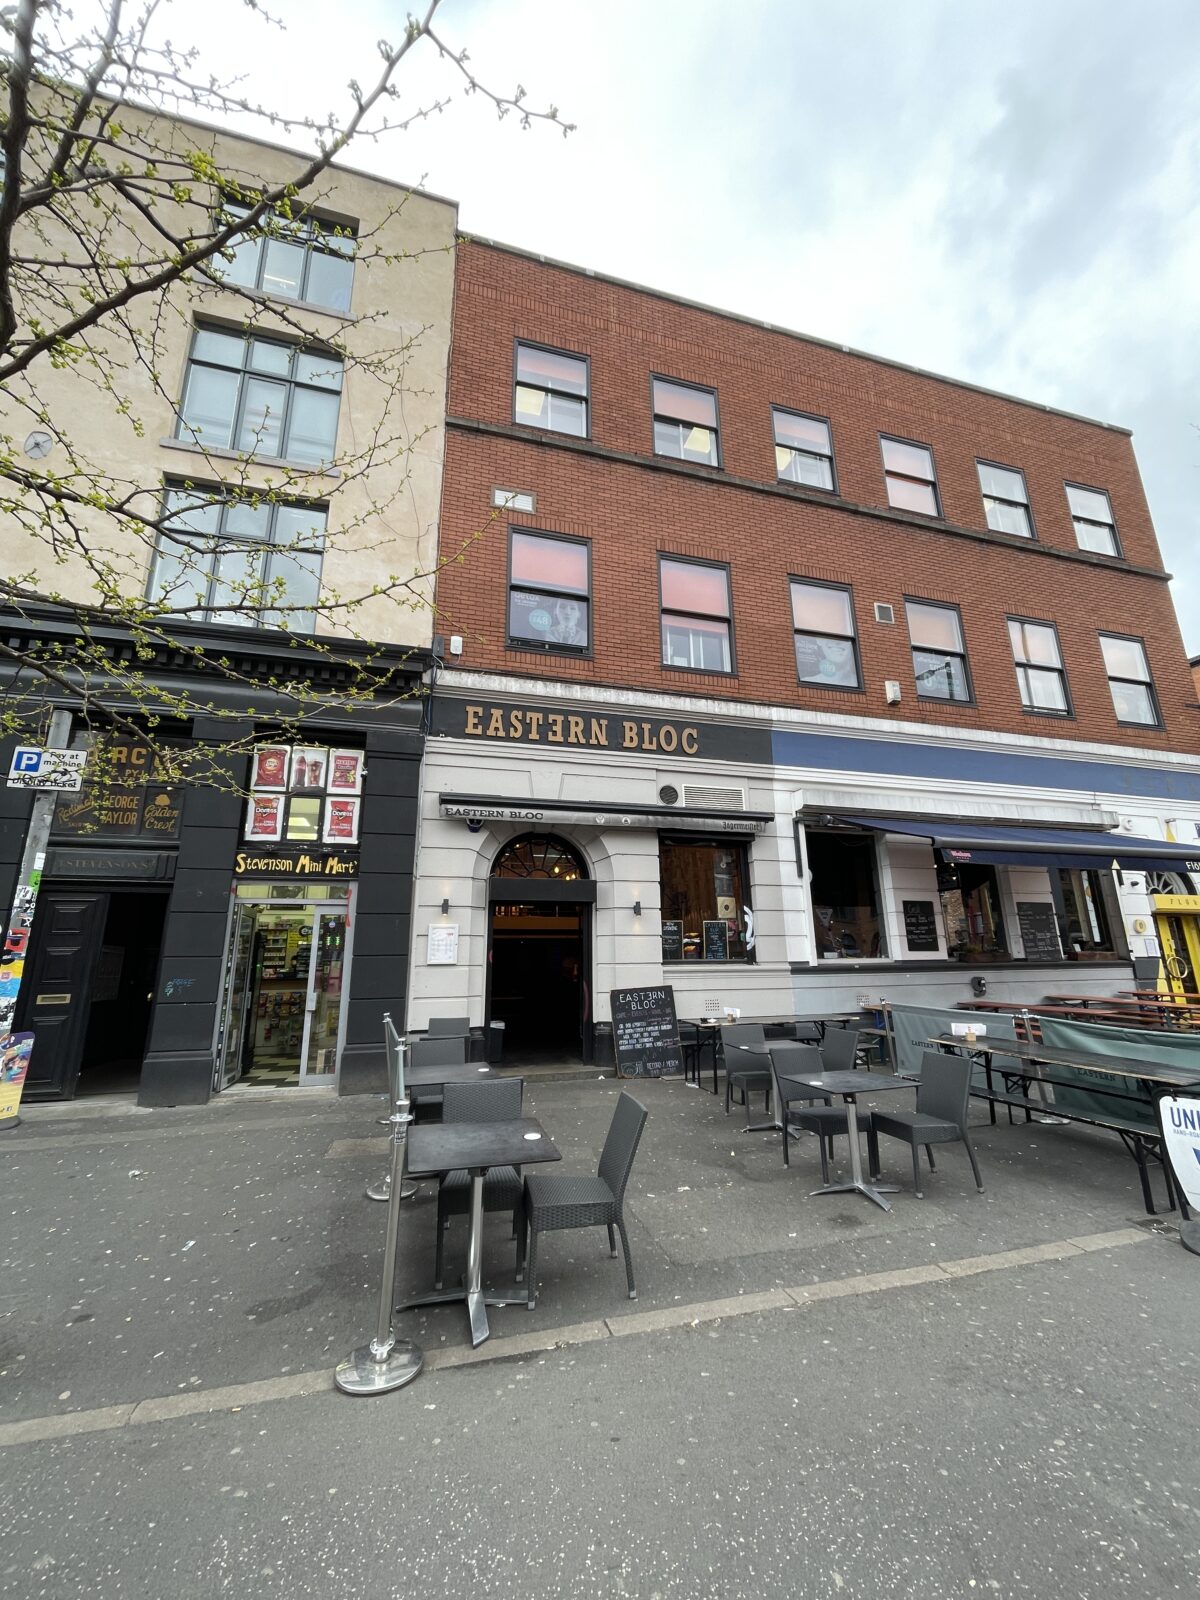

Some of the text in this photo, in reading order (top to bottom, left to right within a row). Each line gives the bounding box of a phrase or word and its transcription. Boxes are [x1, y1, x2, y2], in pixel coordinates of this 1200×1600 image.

[622, 721, 699, 755] BLOC
[20, 753, 38, 770] P
[43, 759, 82, 768] machine
[102, 795, 140, 809] GEORGE
[145, 804, 180, 821] Golden
[444, 807, 544, 820] EASTERN BLOC
[235, 853, 293, 873] Stevenson
[295, 854, 322, 873] Mini
[631, 1000, 656, 1010] BLOC
[911, 1040, 934, 1048] EASTERN
[1077, 1068, 1116, 1082] EASTERN
